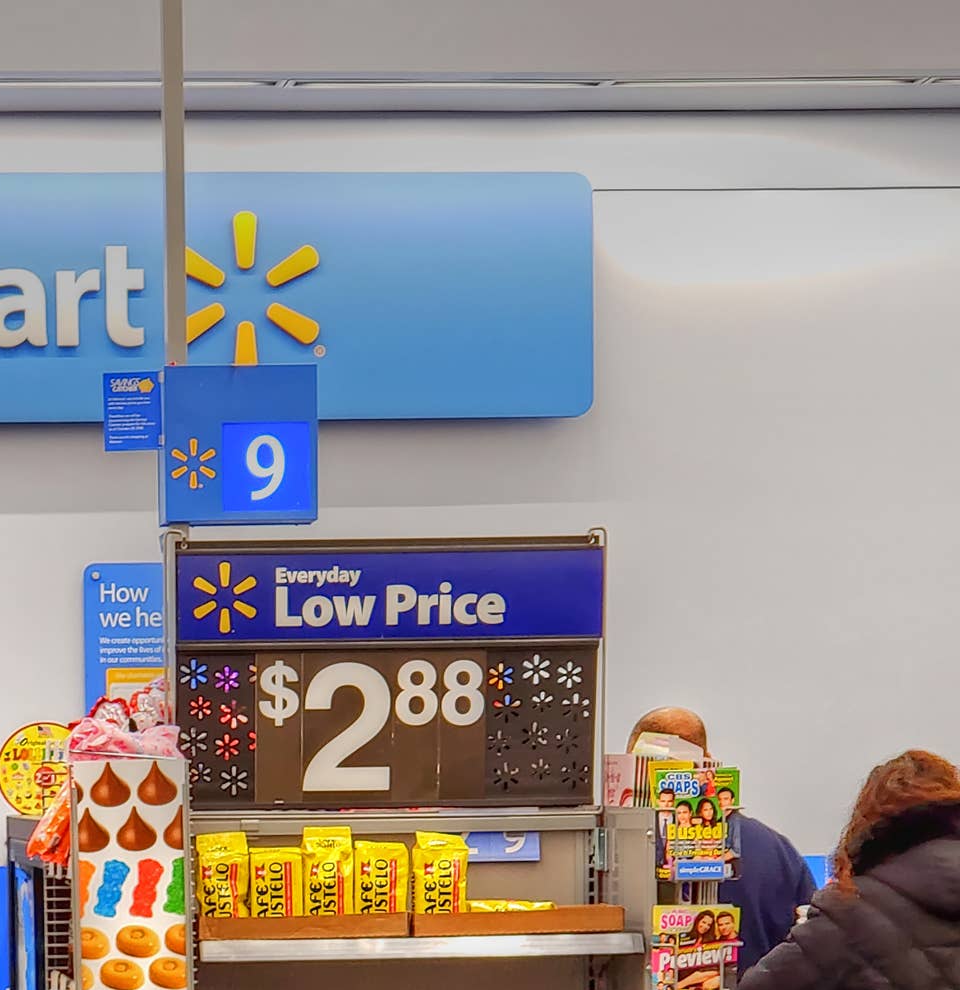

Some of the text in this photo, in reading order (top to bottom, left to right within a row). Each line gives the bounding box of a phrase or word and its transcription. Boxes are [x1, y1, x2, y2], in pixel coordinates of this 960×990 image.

[246, 434, 286, 501] 9
[275, 566, 361, 588] Everyday
[99, 583, 149, 603] How
[275, 582, 507, 628] Low Price
[99, 607, 163, 628] we he
[667, 773, 691, 781] CBS
[660, 780, 699, 797] SOAPS
[667, 822, 728, 840] Busted!
[661, 914, 697, 929] SOAP
[660, 946, 732, 968] Preview!
